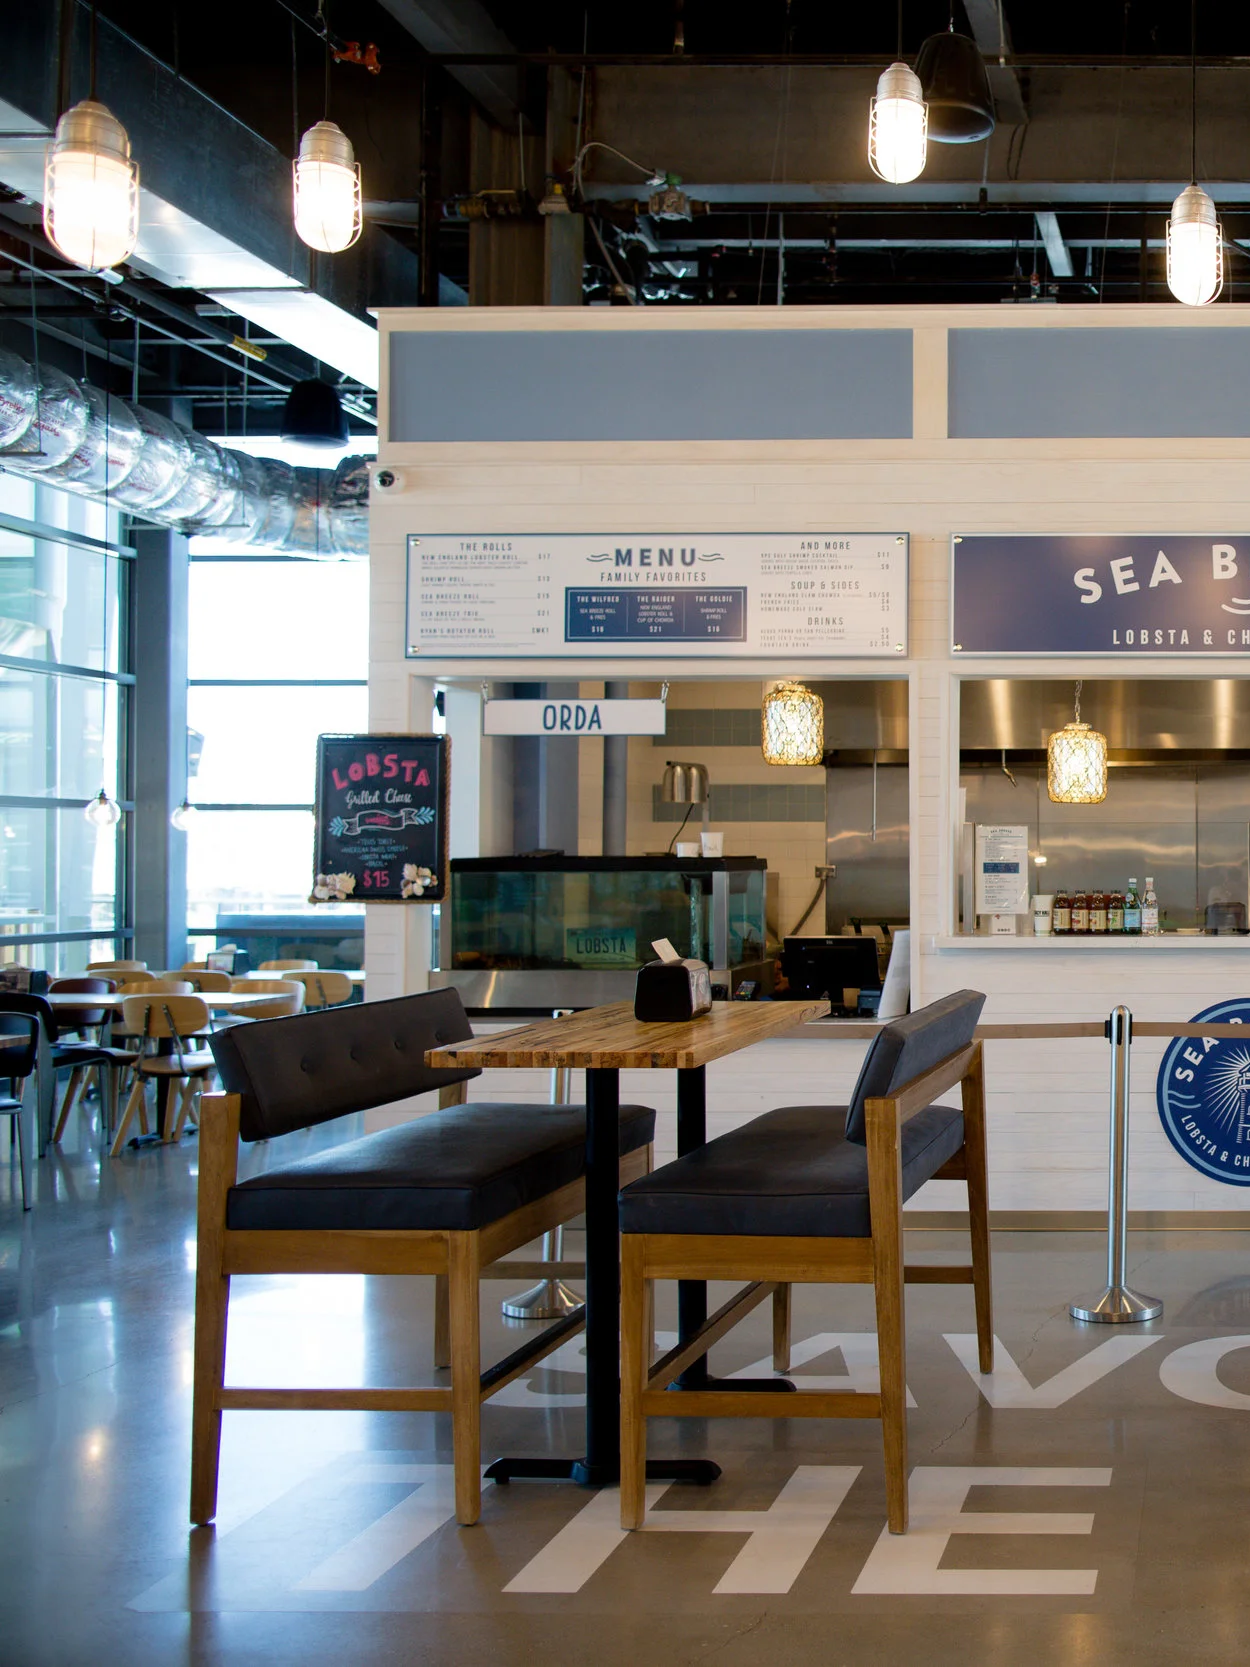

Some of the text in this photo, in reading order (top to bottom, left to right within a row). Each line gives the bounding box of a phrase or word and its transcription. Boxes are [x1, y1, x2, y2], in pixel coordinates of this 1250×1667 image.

[615, 548, 696, 566] MENU
[601, 573, 706, 582] FAMILY FAVORITES
[1074, 550, 1182, 604] SEA
[1112, 630, 1190, 644] LOBSTA
[1204, 630, 1214, 644] &
[543, 705, 602, 731] ORDA
[332, 753, 430, 790] LOBSTA
[345, 788, 412, 809] Grilled Cheese
[363, 870, 389, 888] $15
[577, 938, 626, 954] LOBSTA
[1181, 1115, 1216, 1154] LOBSTA
[1220, 1152, 1228, 1162] &
[294, 1464, 1113, 1594] THE
